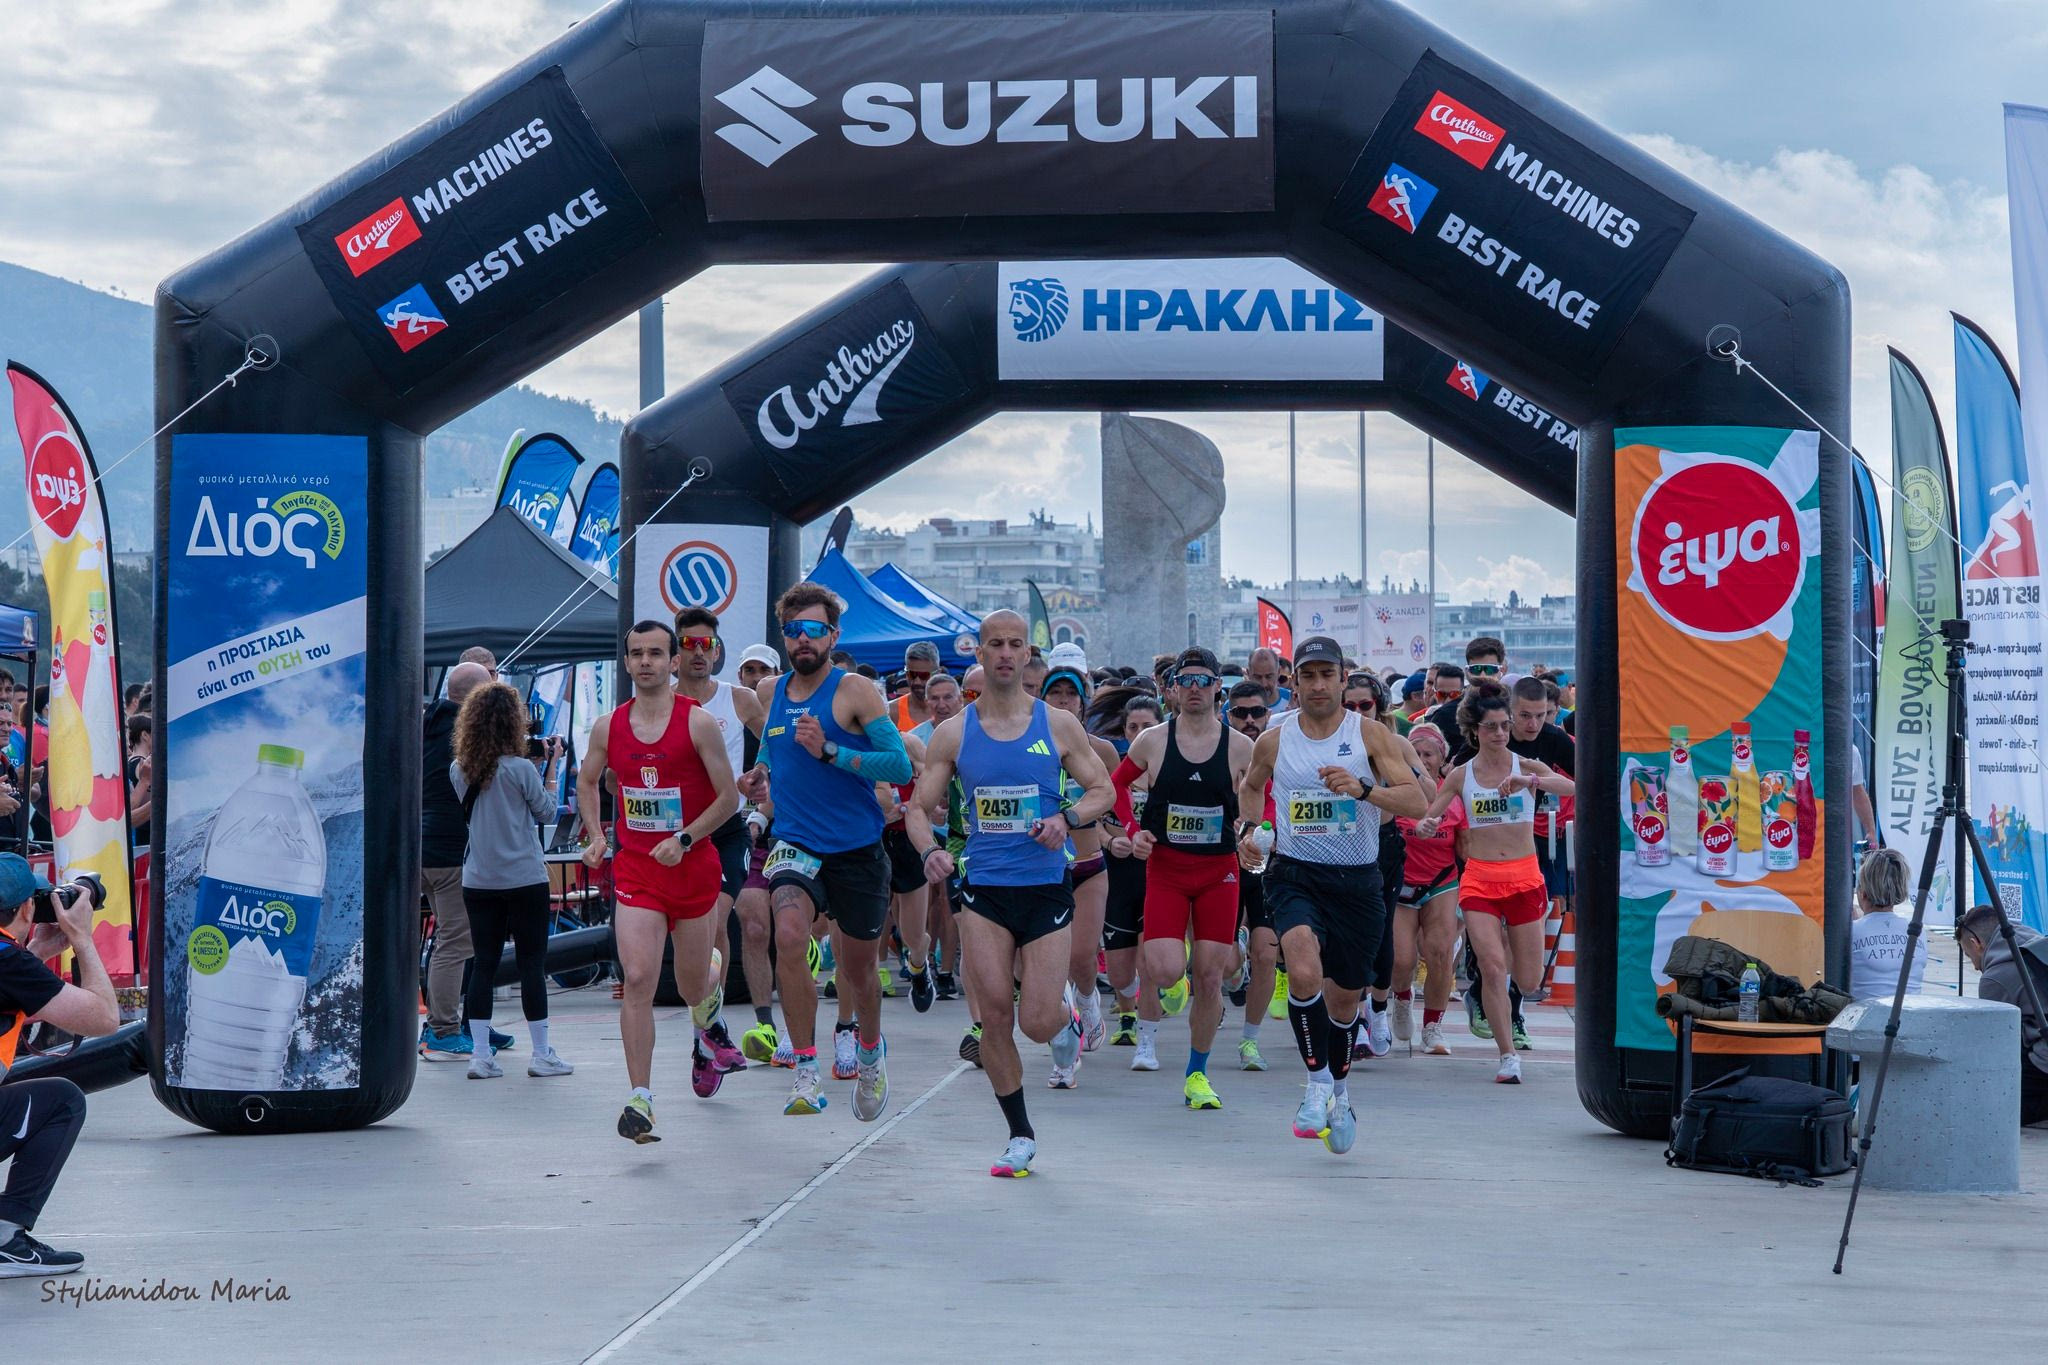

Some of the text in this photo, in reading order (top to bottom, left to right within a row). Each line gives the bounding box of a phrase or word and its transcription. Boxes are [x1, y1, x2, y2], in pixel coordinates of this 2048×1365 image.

[841, 75, 1258, 147] SUZUKI
[1430, 104, 1495, 142] Anthrax
[412, 118, 553, 223] MACHINES
[1494, 143, 1641, 248] MACHINES
[346, 210, 403, 257] Anthrax
[445, 187, 608, 305] BEST RACE
[1437, 212, 1600, 329] BEST RACE
[1083, 289, 1373, 332] ΗΡΑΚΛΗΣ
[757, 318, 915, 449] Anthrax
[1493, 386, 1579, 451] BEST RA
[198, 473, 330, 486] φυσικό μεταλλικό νερό
[185, 495, 319, 569] Διός
[327, 511, 341, 551] ΟΛΥΜΠΟ
[207, 626, 305, 672] η ΠΡΟΣΤΑΣΙΑ
[197, 642, 331, 699] είναι στη ΦΥΣΗ του
[627, 799, 660, 816] 2481
[628, 820, 656, 828] COSMOS
[981, 799, 1019, 817] 2437
[1171, 816, 1204, 831] 2186
[1294, 801, 1333, 820] 2318
[1475, 799, 1508, 814] 2488
[981, 822, 1013, 830] COSMOS
[1169, 834, 1198, 842] COSMOS
[1294, 825, 1328, 833] COSMOS
[767, 848, 797, 867] 2119
[219, 895, 285, 938] Διός
[197, 947, 218, 956] UNESCO
[1853, 935, 1889, 950] ΥΛΛΟΓΟΣ
[1868, 949, 1914, 960] ΑΡΤΑ
